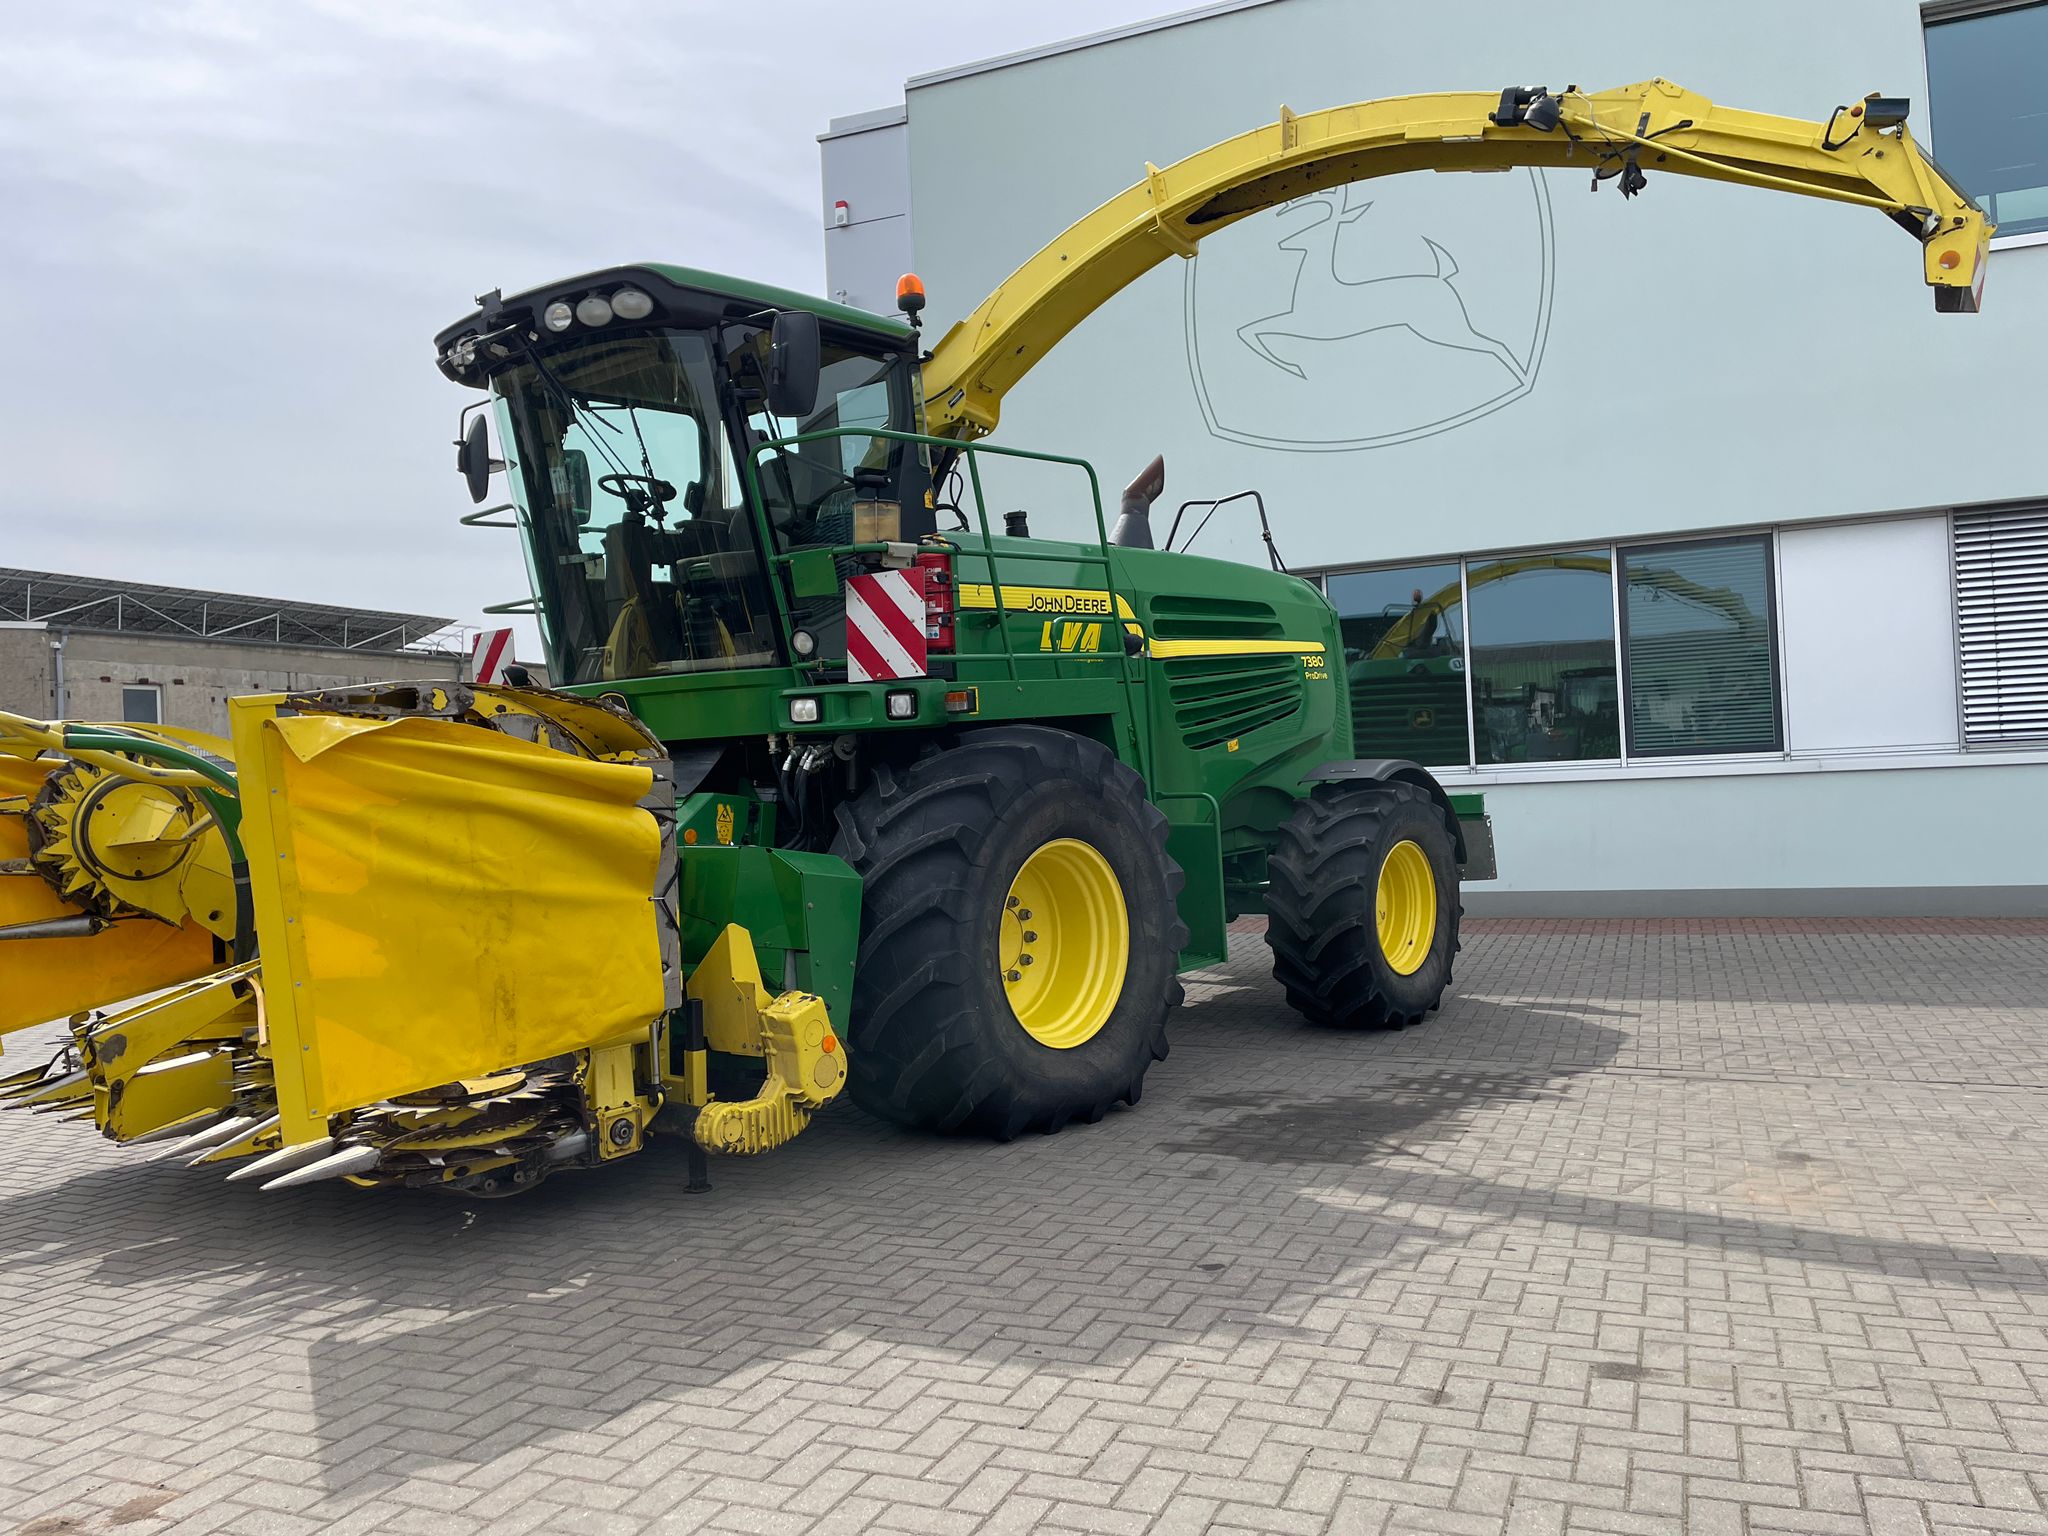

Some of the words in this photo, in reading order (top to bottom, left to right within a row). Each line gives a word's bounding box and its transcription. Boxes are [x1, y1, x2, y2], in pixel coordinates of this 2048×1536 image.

[1027, 593, 1063, 610] JOHN
[1065, 595, 1108, 612] DEERE
[1301, 655, 1324, 668] 7380
[1304, 671, 1328, 680] ProDrive
